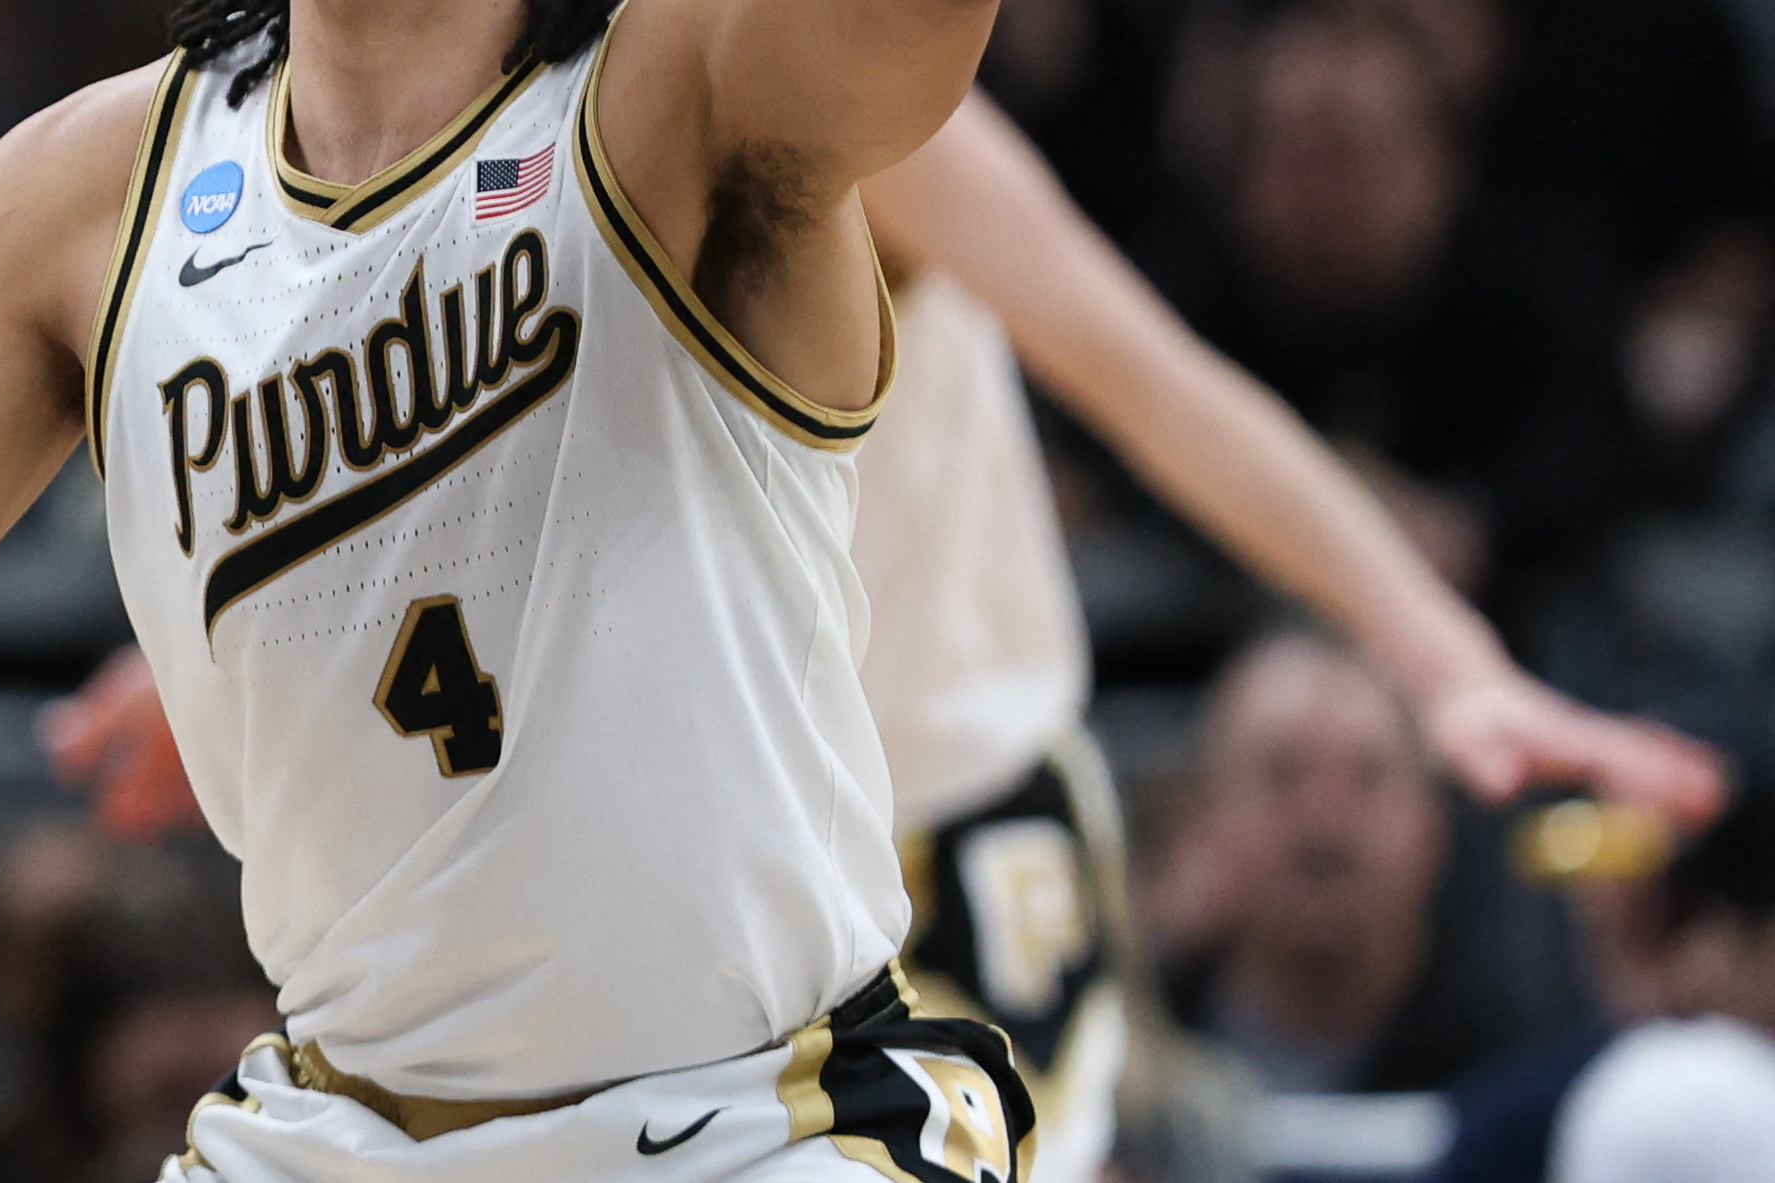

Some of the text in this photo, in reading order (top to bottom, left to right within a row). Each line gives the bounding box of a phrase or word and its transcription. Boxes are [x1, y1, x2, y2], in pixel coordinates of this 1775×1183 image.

[186, 192, 237, 216] NCAA
[157, 228, 556, 558] Purdue
[372, 594, 504, 778] 4
